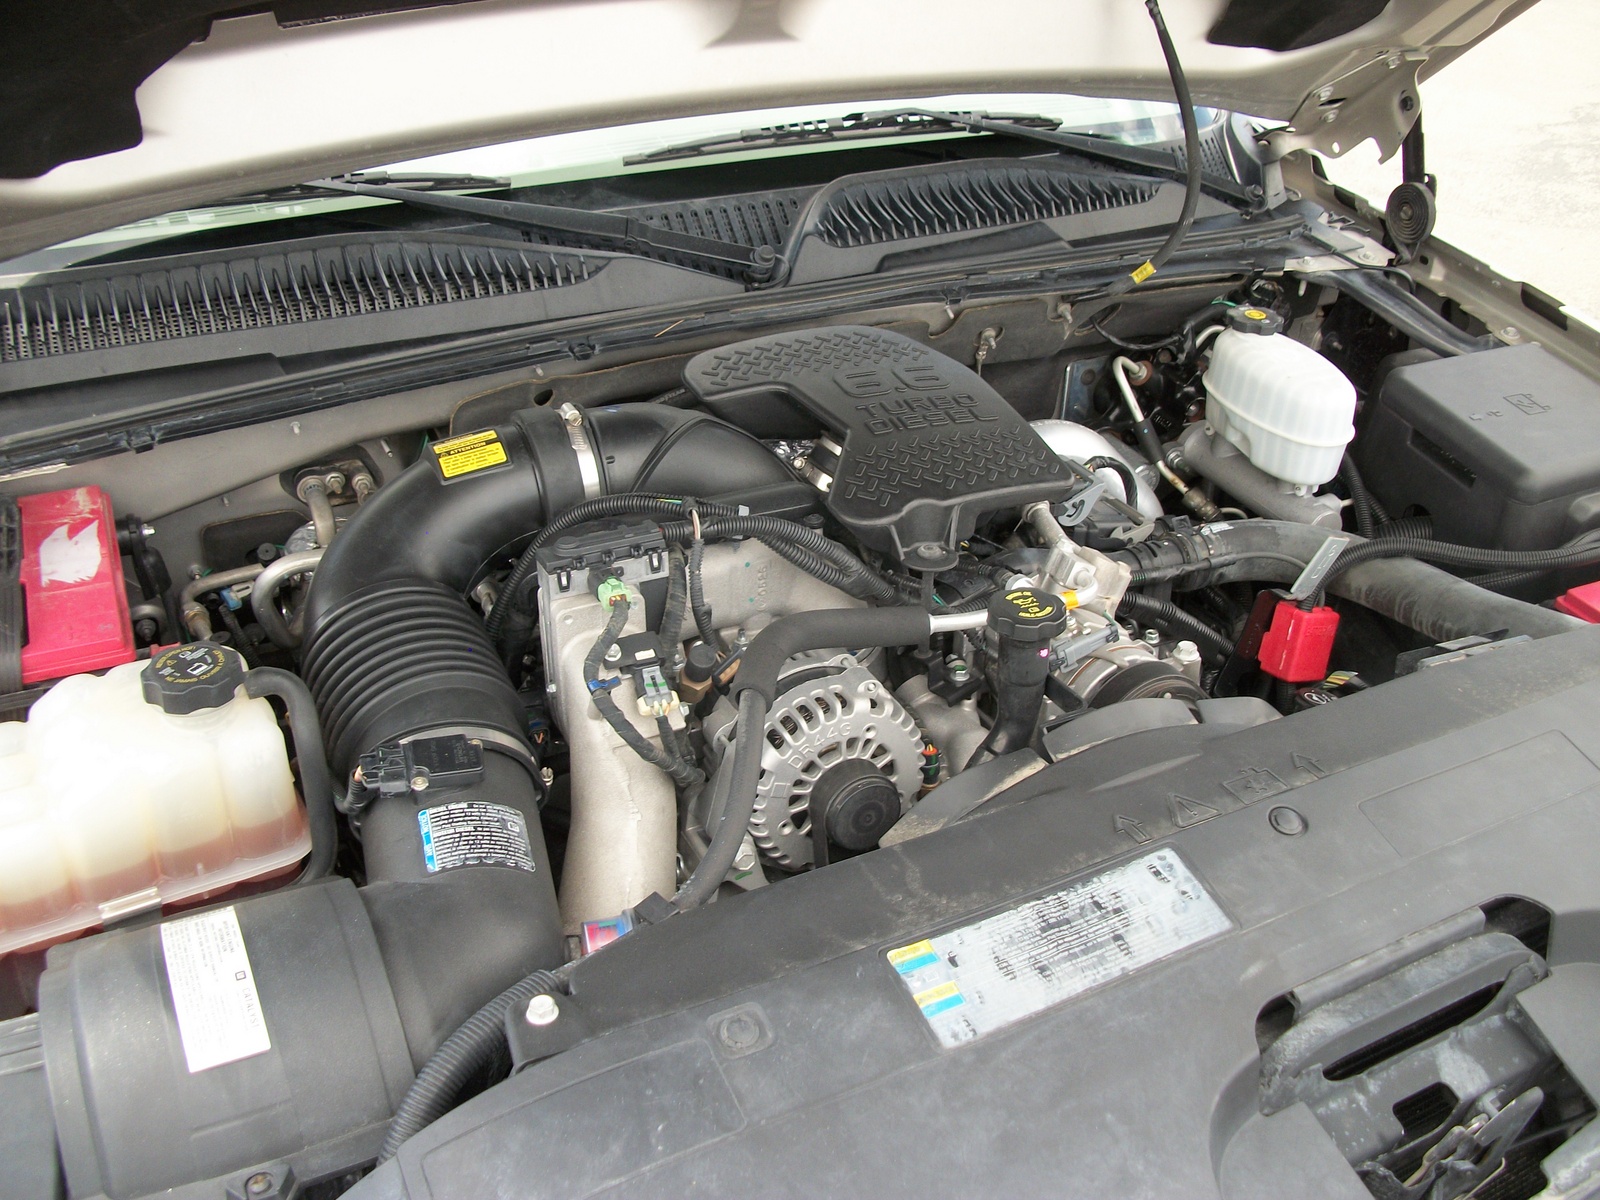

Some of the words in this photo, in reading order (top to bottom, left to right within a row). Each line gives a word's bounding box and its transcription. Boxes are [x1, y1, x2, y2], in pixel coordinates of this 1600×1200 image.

[832, 365, 950, 398] 6.6
[856, 392, 980, 417] TURBO
[864, 404, 999, 435] DIESEL
